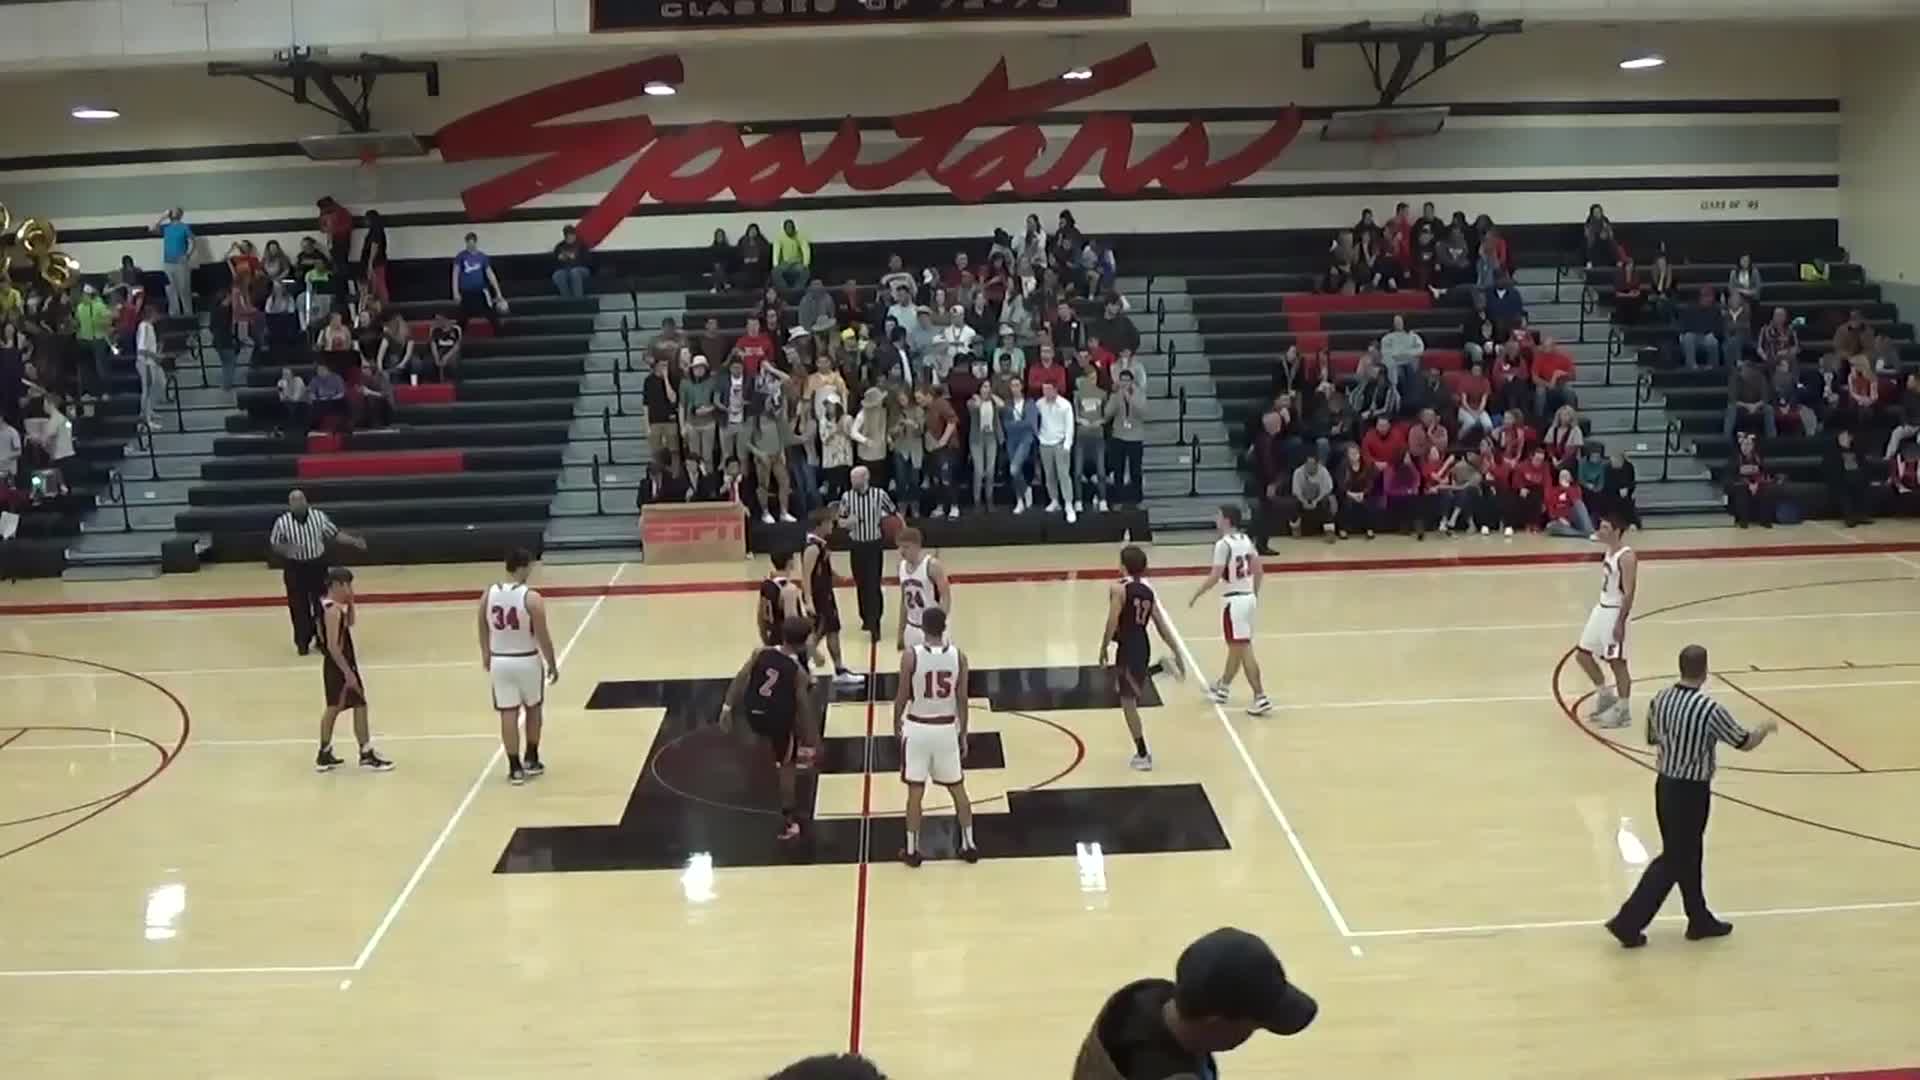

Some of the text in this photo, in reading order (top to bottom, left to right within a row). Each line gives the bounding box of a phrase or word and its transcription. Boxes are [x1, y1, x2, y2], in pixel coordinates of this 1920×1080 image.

[433, 42, 1303, 250] Spartans
[644, 514, 743, 545] ESPN
[904, 590, 925, 609] 24
[491, 605, 520, 631] 34
[759, 668, 779, 697] 2
[924, 671, 952, 699] 15
